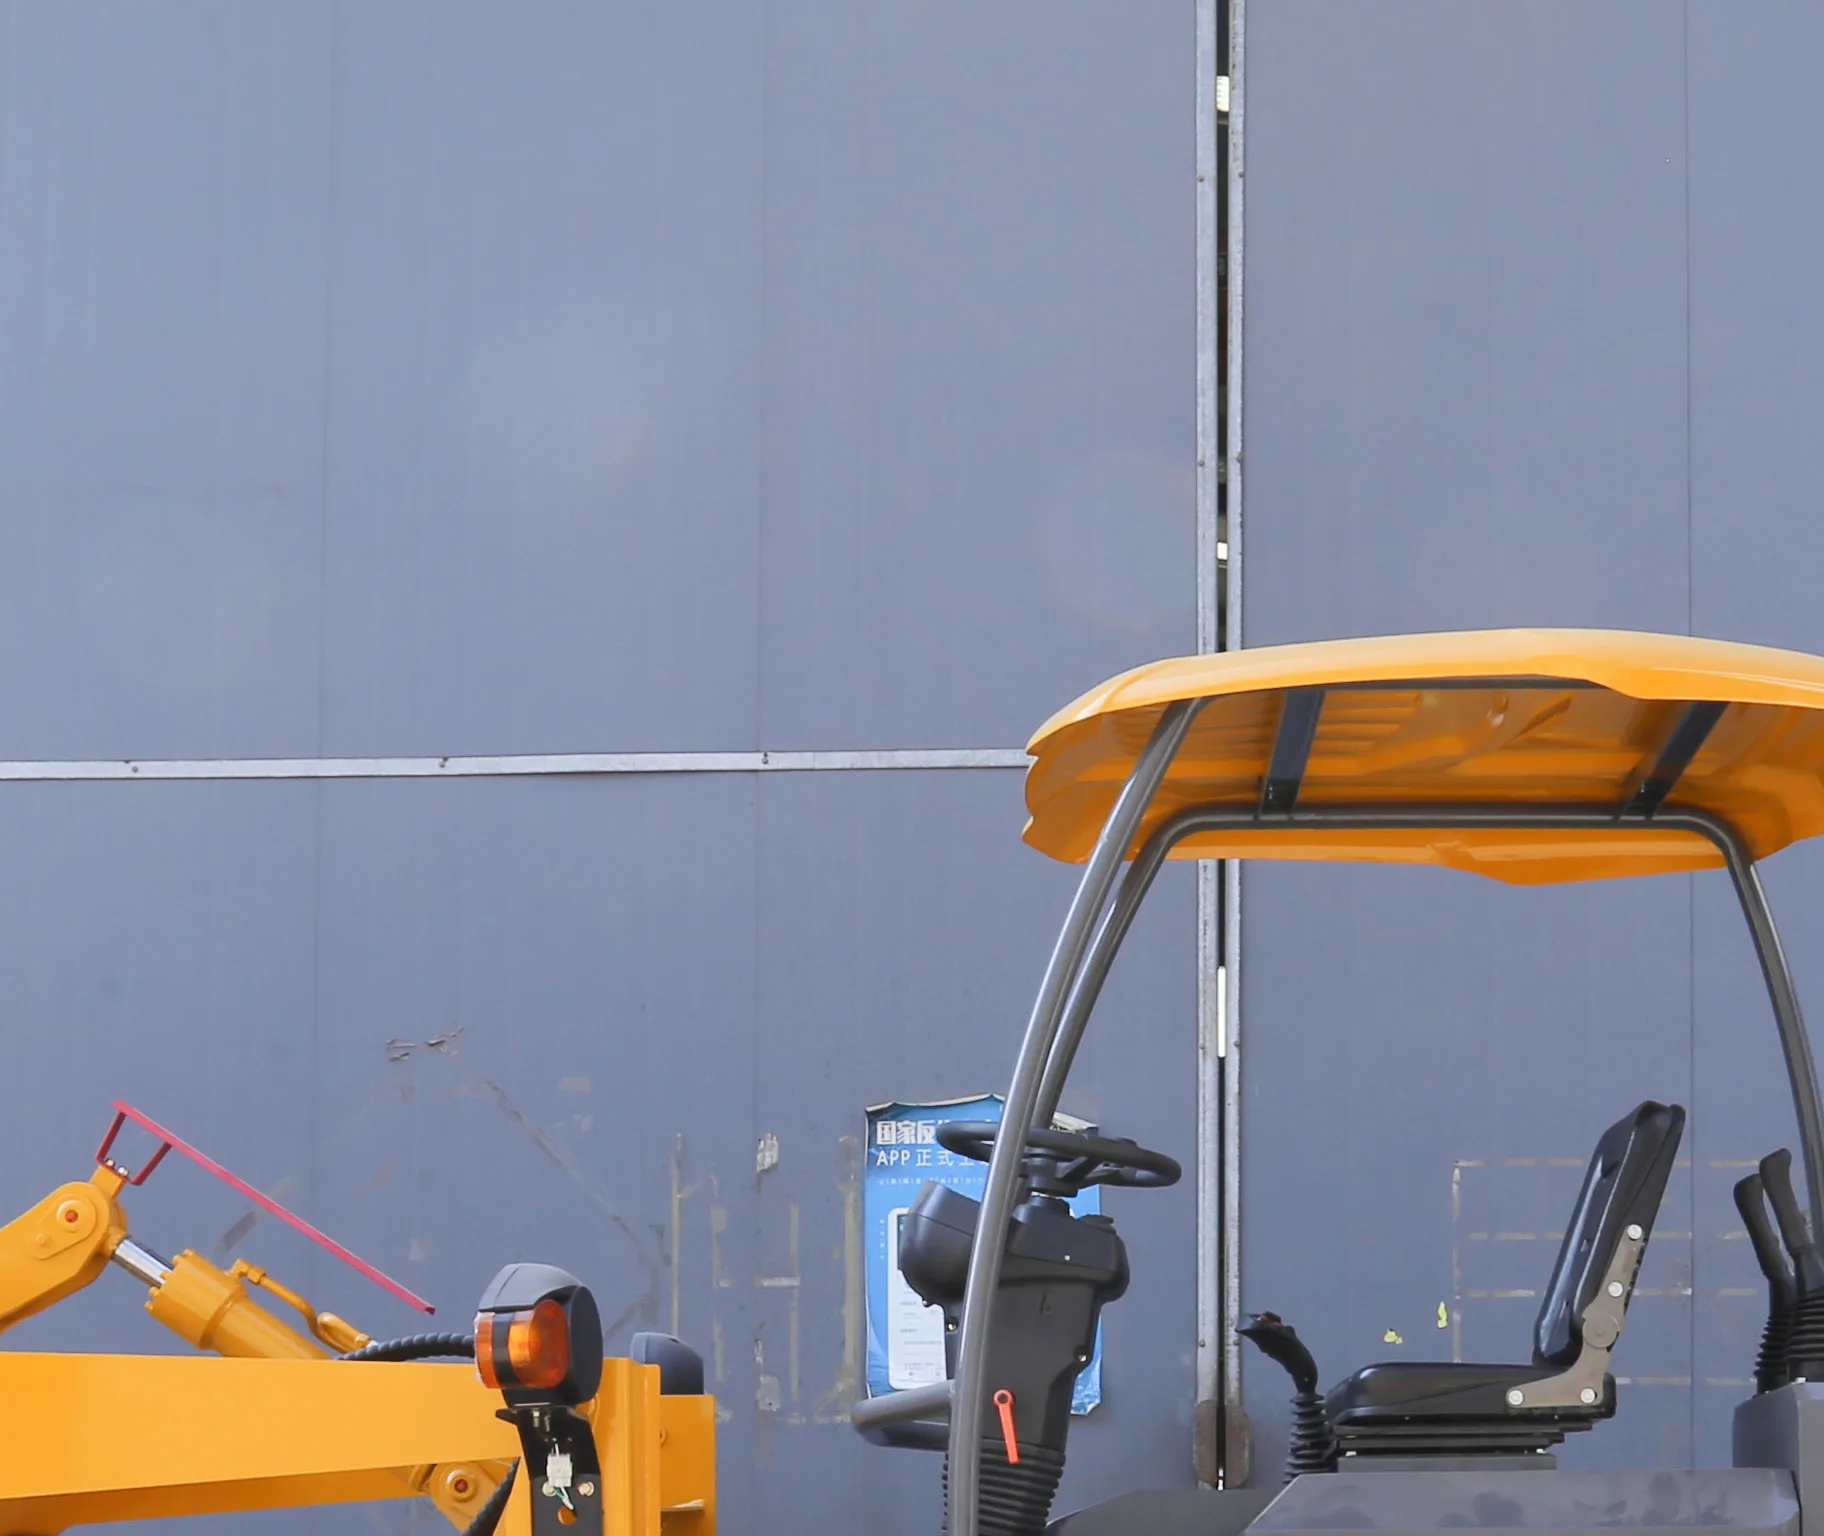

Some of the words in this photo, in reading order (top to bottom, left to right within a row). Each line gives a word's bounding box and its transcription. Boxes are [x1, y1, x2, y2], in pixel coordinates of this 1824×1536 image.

[876, 1119, 950, 1145] 国家反
[876, 1149, 911, 1167] APP
